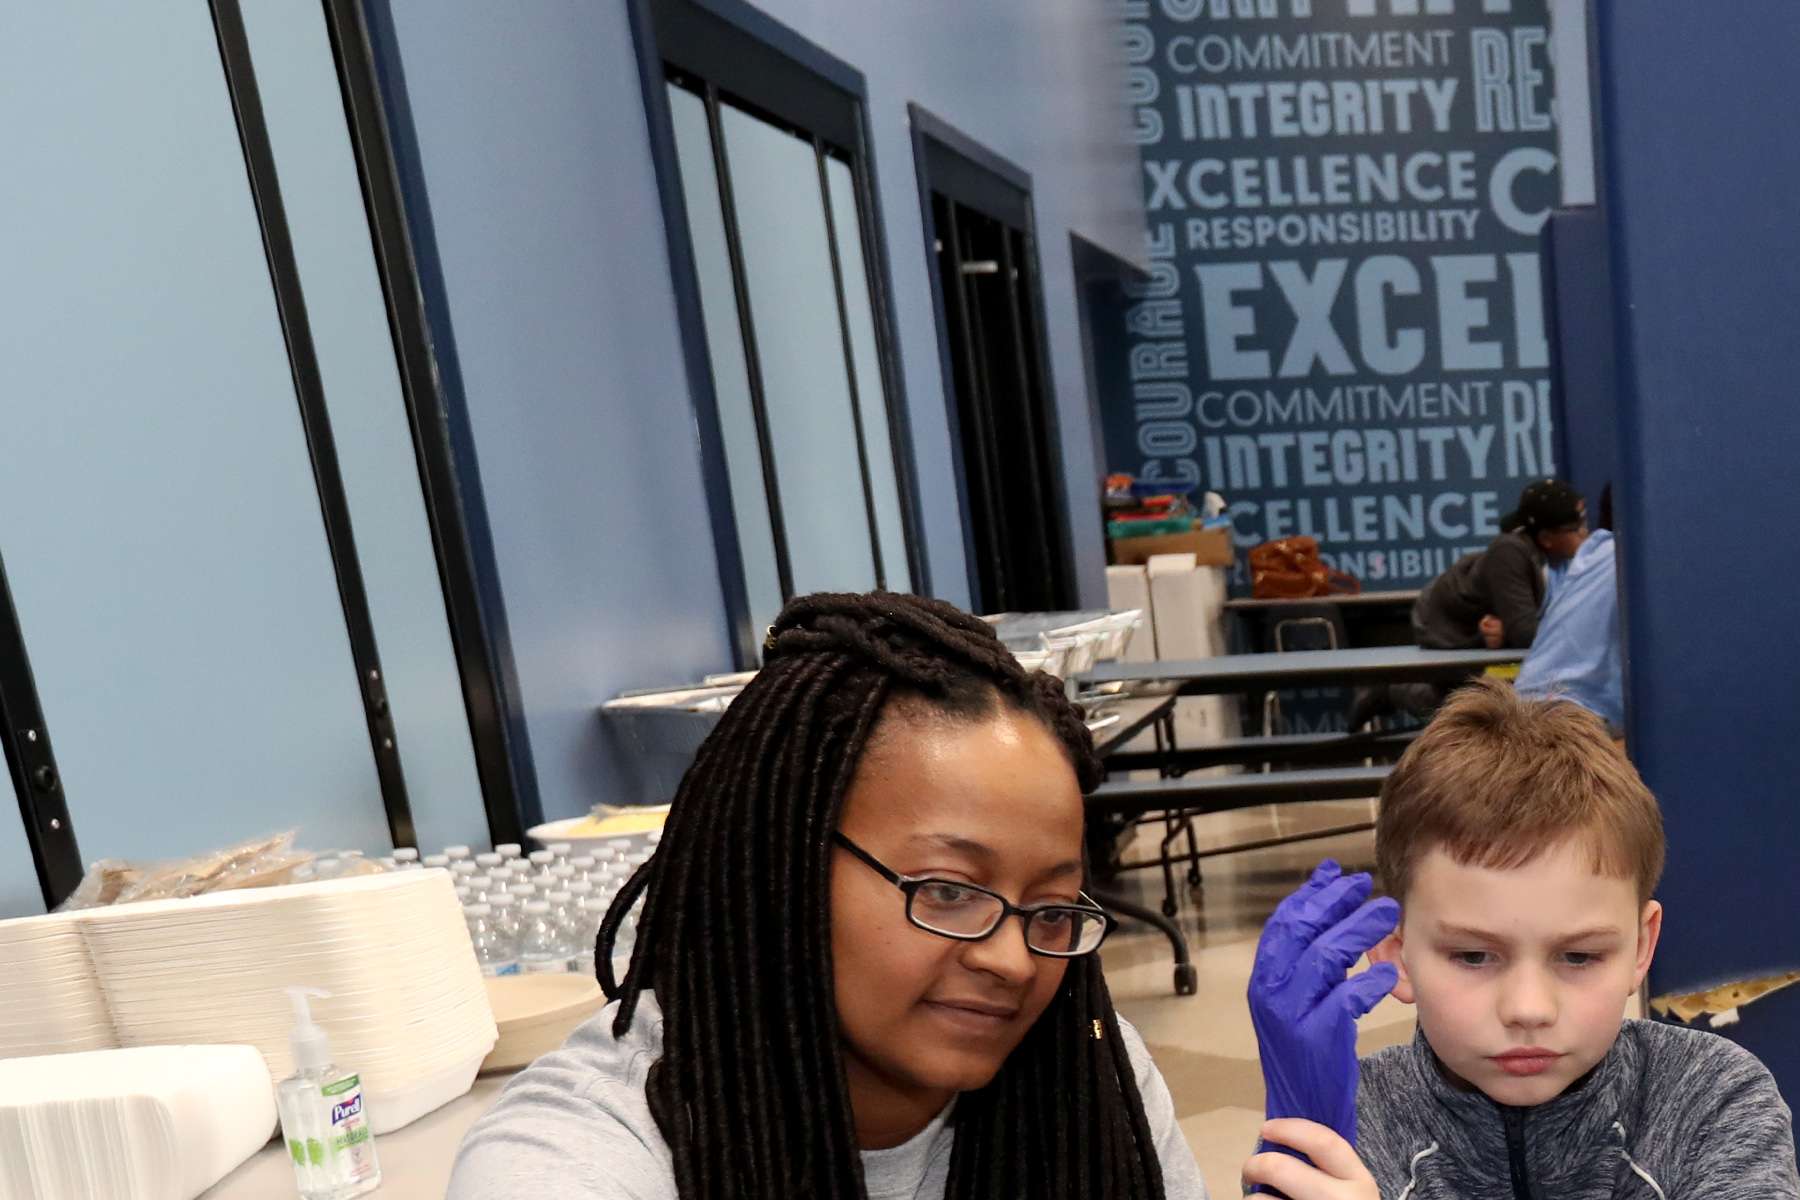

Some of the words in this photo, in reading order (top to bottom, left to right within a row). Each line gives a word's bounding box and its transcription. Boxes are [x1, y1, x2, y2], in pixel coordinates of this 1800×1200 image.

[1167, 30, 1455, 74] COMMITMENT
[1175, 78, 1459, 140] INTEGRITY
[1145, 151, 1477, 210] XCELLENCE
[1187, 209, 1480, 249] RESPONSIBILITY
[1195, 381, 1492, 427] COMMITMENT
[1205, 425, 1495, 491] INTEGRITY
